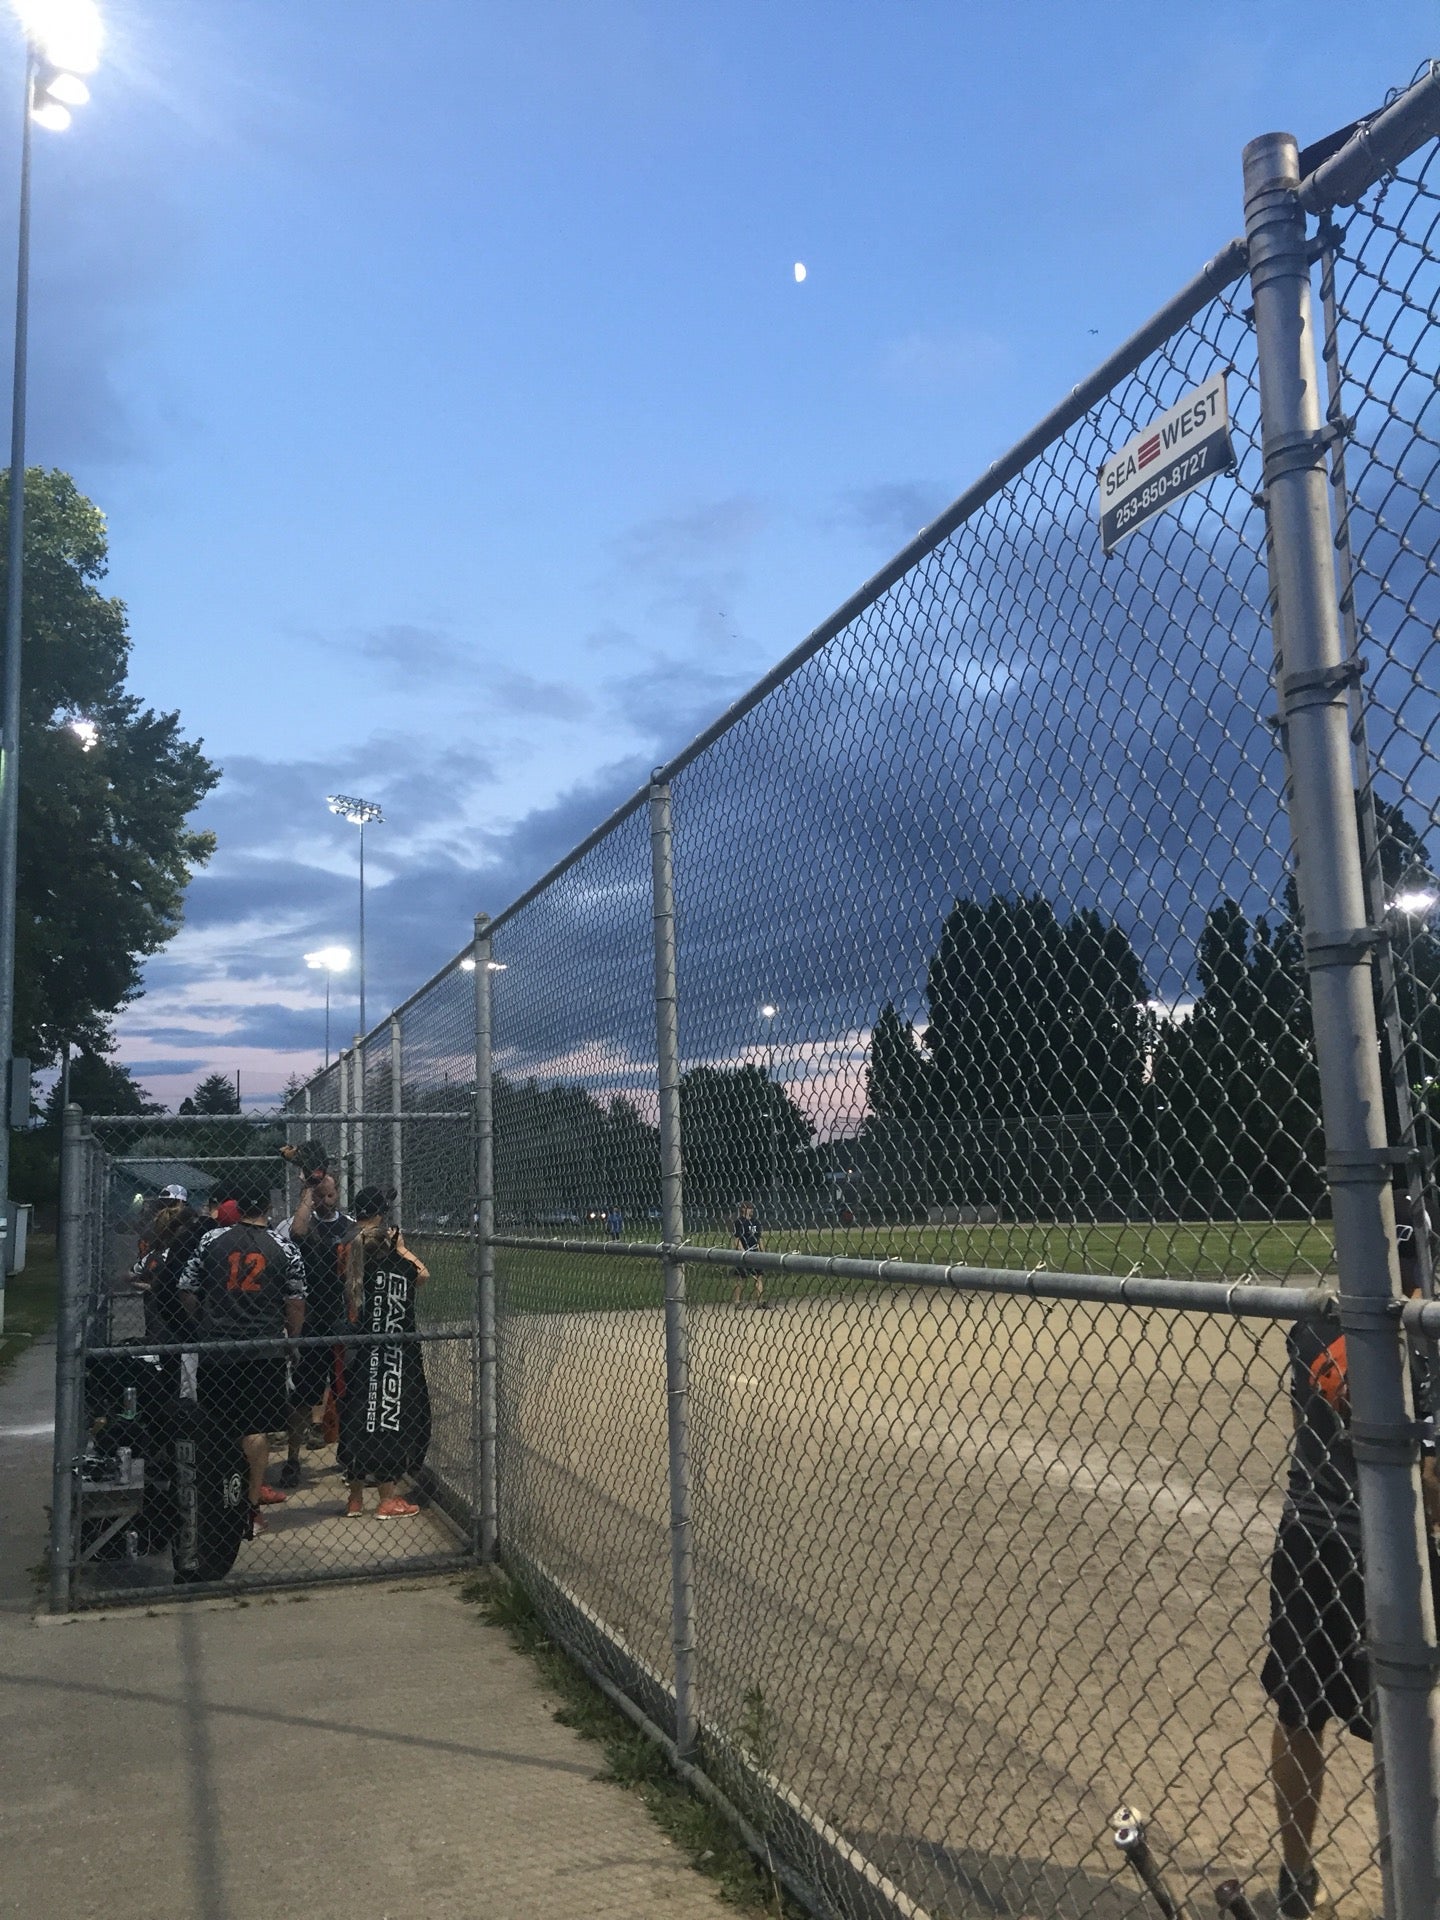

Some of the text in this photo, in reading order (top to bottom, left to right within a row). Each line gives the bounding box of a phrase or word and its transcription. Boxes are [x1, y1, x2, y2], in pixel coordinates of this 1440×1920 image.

[1106, 388, 1219, 497] SEA WEST
[1116, 446, 1208, 529] 253-850-8727
[226, 1251, 267, 1291] 12
[366, 1342, 380, 1433] NGINEERED
